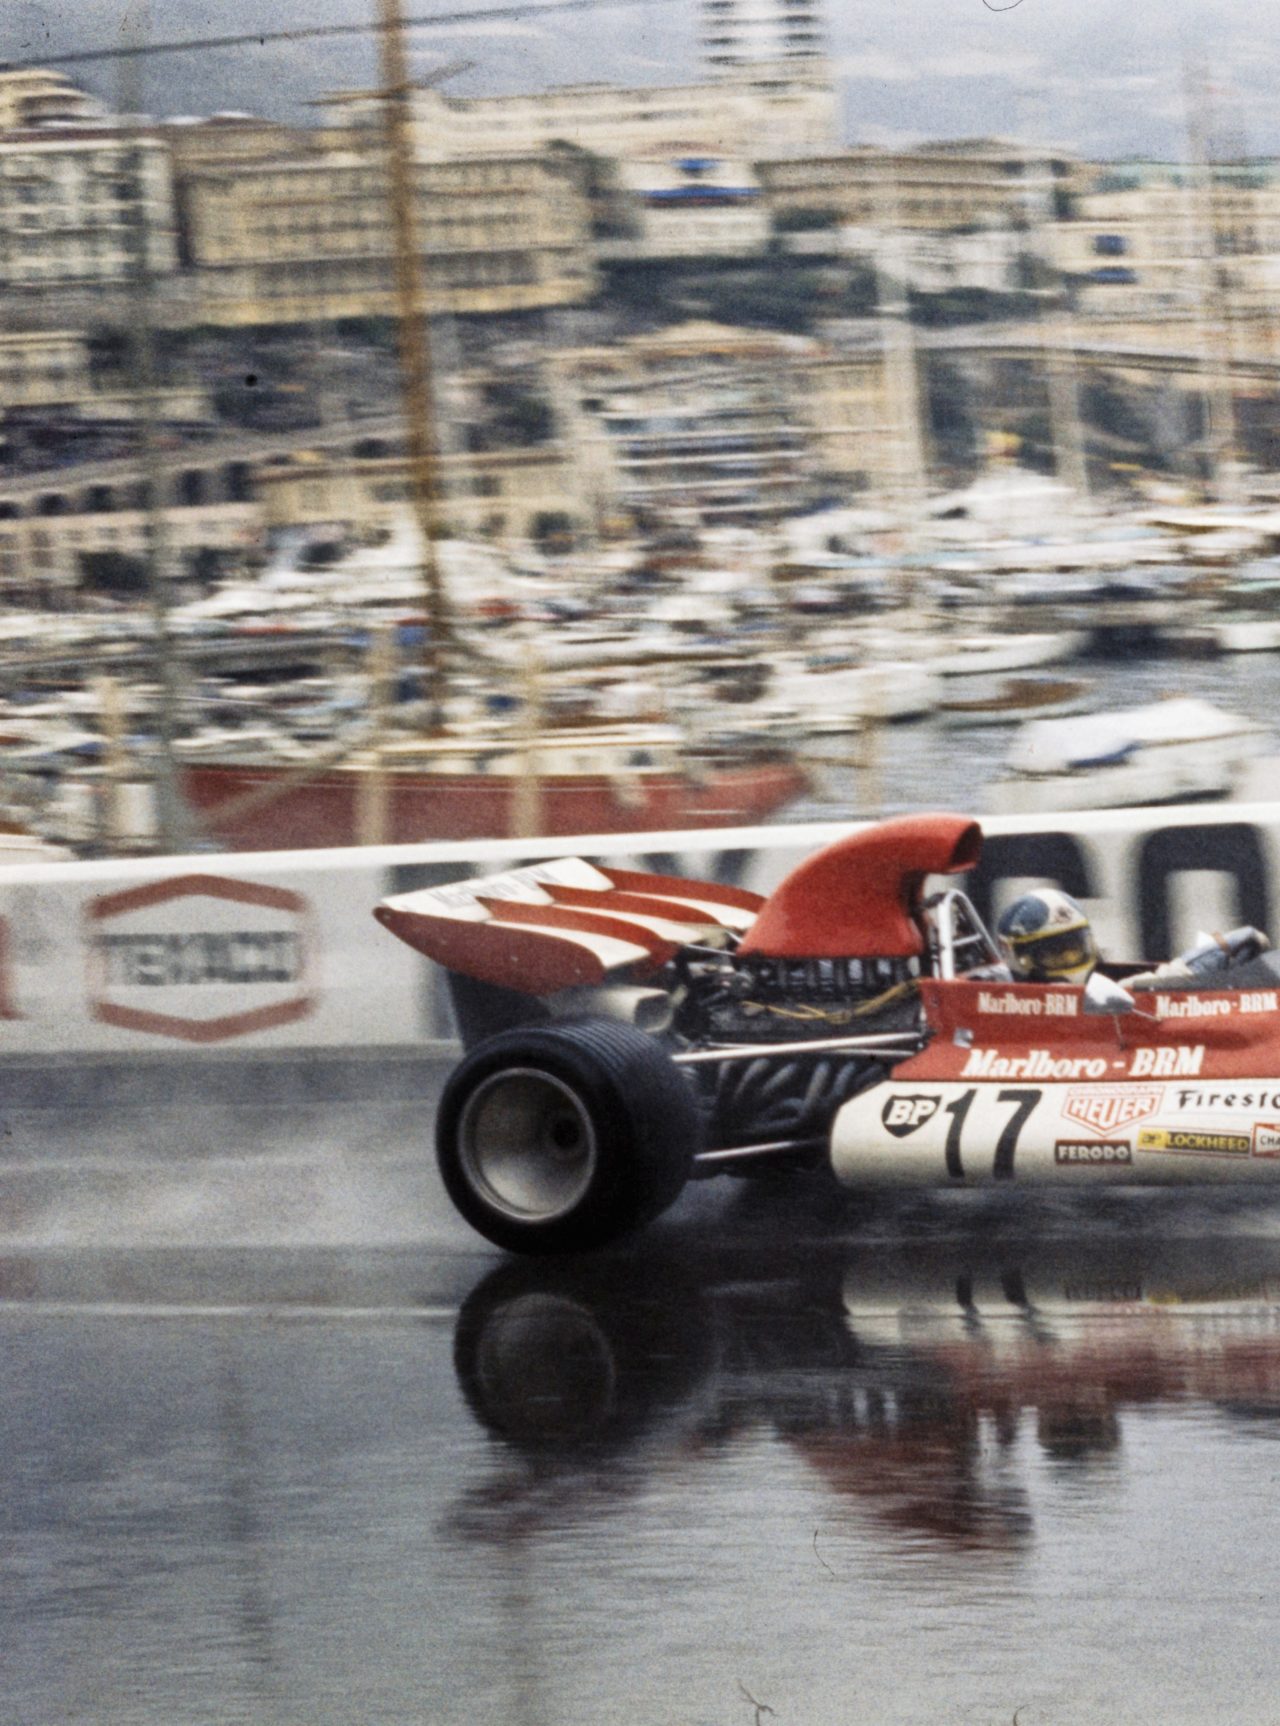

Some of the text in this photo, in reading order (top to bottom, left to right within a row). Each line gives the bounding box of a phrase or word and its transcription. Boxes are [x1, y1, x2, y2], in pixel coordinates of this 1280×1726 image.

[1156, 995, 1232, 1018] Marlboro
[1239, 993, 1279, 1012] BRM
[960, 1049, 1107, 1078] Marlboro
[1129, 1046, 1206, 1077] BRM
[885, 1100, 937, 1126] BP
[1069, 1097, 1154, 1129] HEUER
[945, 1088, 1043, 1179] 17
[1167, 1133, 1249, 1151] LOCKHEED
[1058, 1145, 1129, 1161] FERODO
